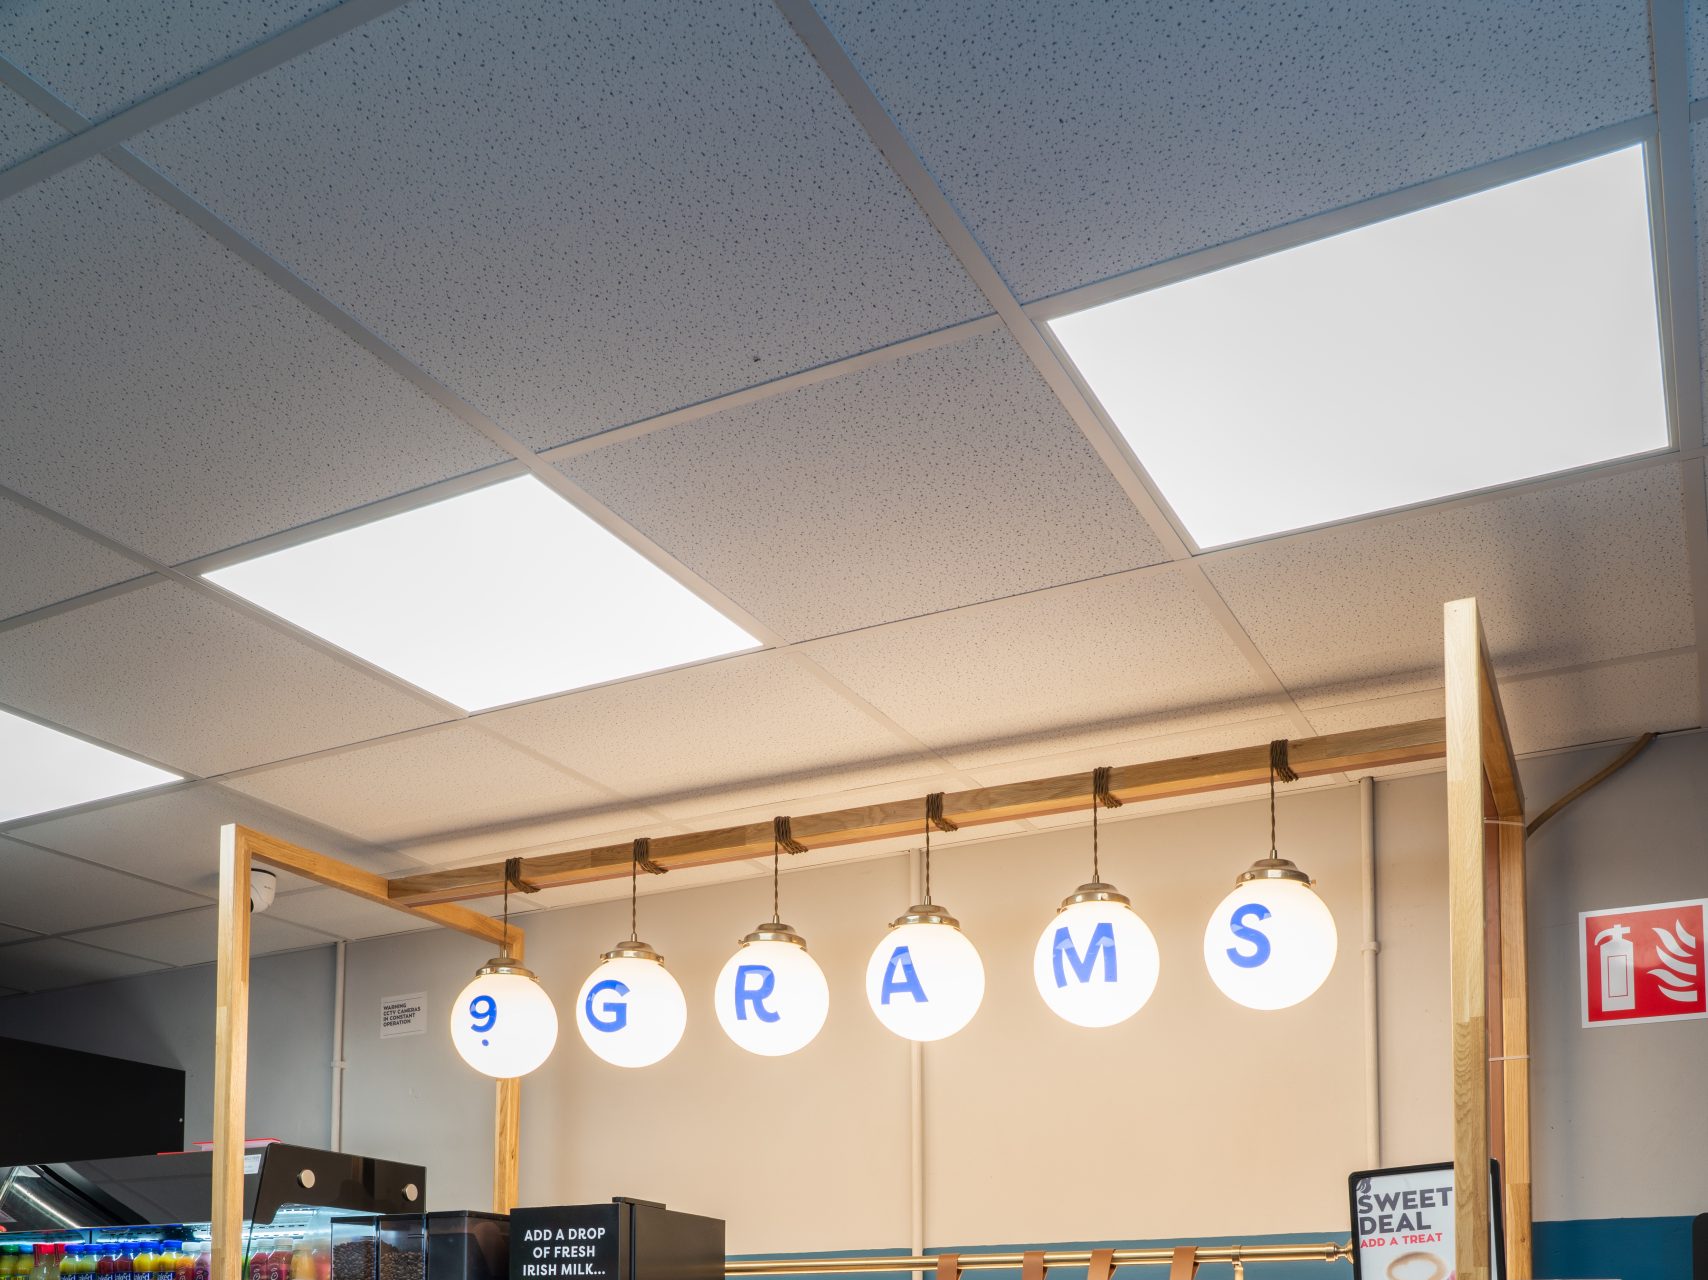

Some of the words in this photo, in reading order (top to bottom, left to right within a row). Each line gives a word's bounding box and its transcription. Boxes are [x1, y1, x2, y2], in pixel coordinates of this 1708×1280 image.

[398, 1006, 421, 1014] CAMERAS
[383, 1019, 411, 1027] OPERATION
[1358, 1186, 1453, 1214] SWEET
[1360, 1211, 1432, 1235] DEAL
[524, 1229, 552, 1242] ADD
[555, 1228, 565, 1241] A
[568, 1227, 606, 1240] DROP
[1360, 1237, 1386, 1248] ADD
[1389, 1237, 1398, 1246] A
[1401, 1232, 1443, 1244] TREAT
[532, 1247, 551, 1258] OF
[554, 1245, 596, 1258] FRESH
[523, 1264, 557, 1276] IRISH
[561, 1263, 606, 1276] MILK...
